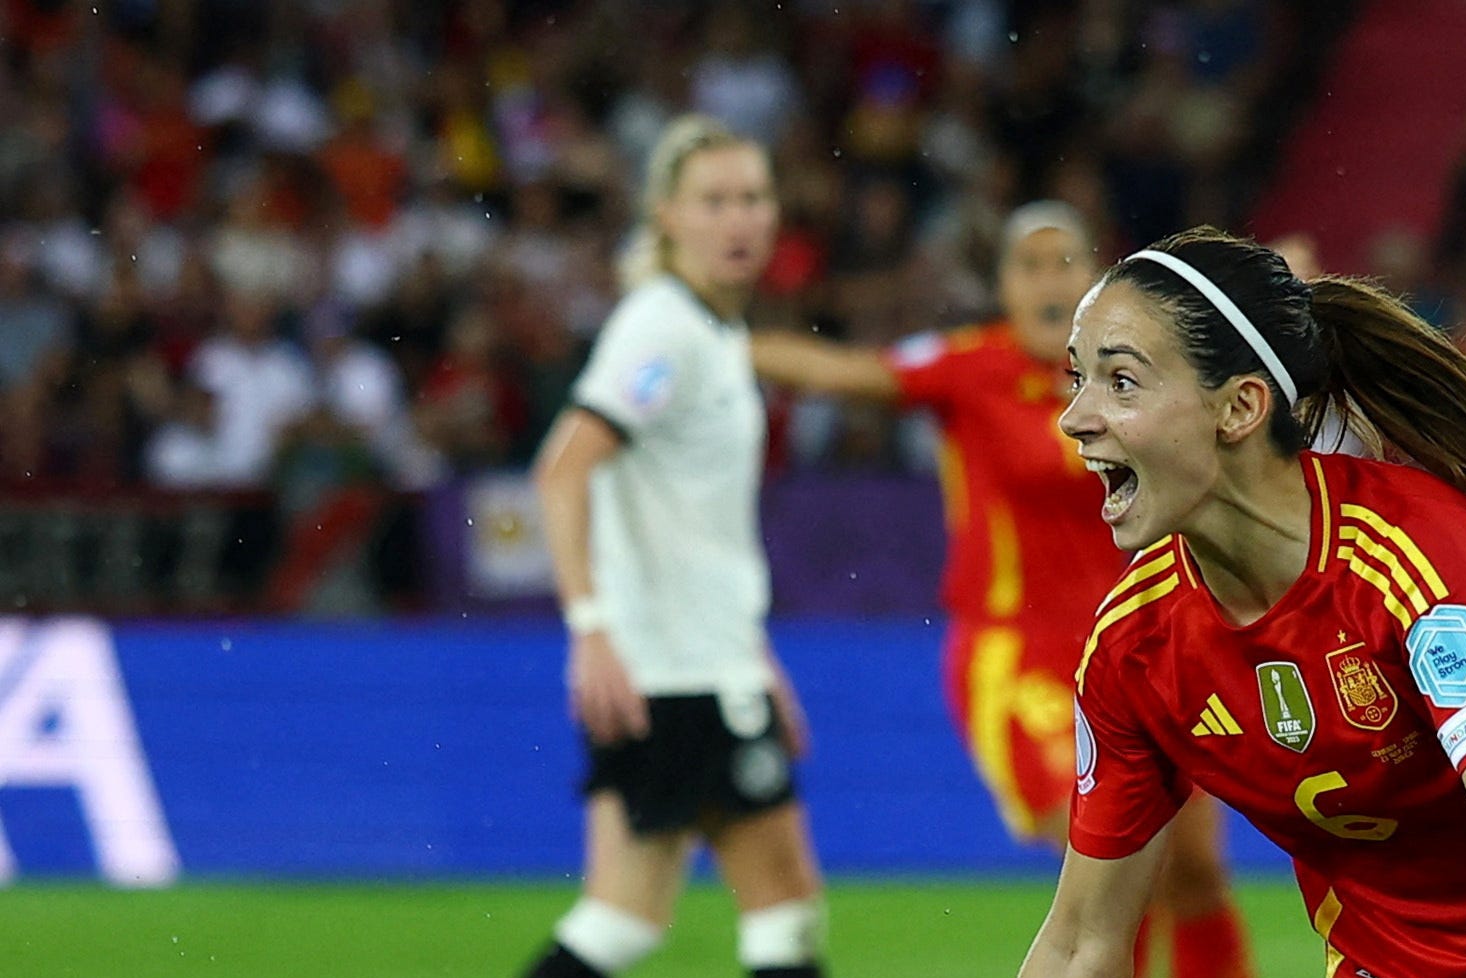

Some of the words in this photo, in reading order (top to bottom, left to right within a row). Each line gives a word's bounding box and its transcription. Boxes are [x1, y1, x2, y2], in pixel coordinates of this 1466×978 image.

[0, 615, 181, 888] A
[1277, 720, 1302, 733] FIFA
[1294, 770, 1398, 841] 6
